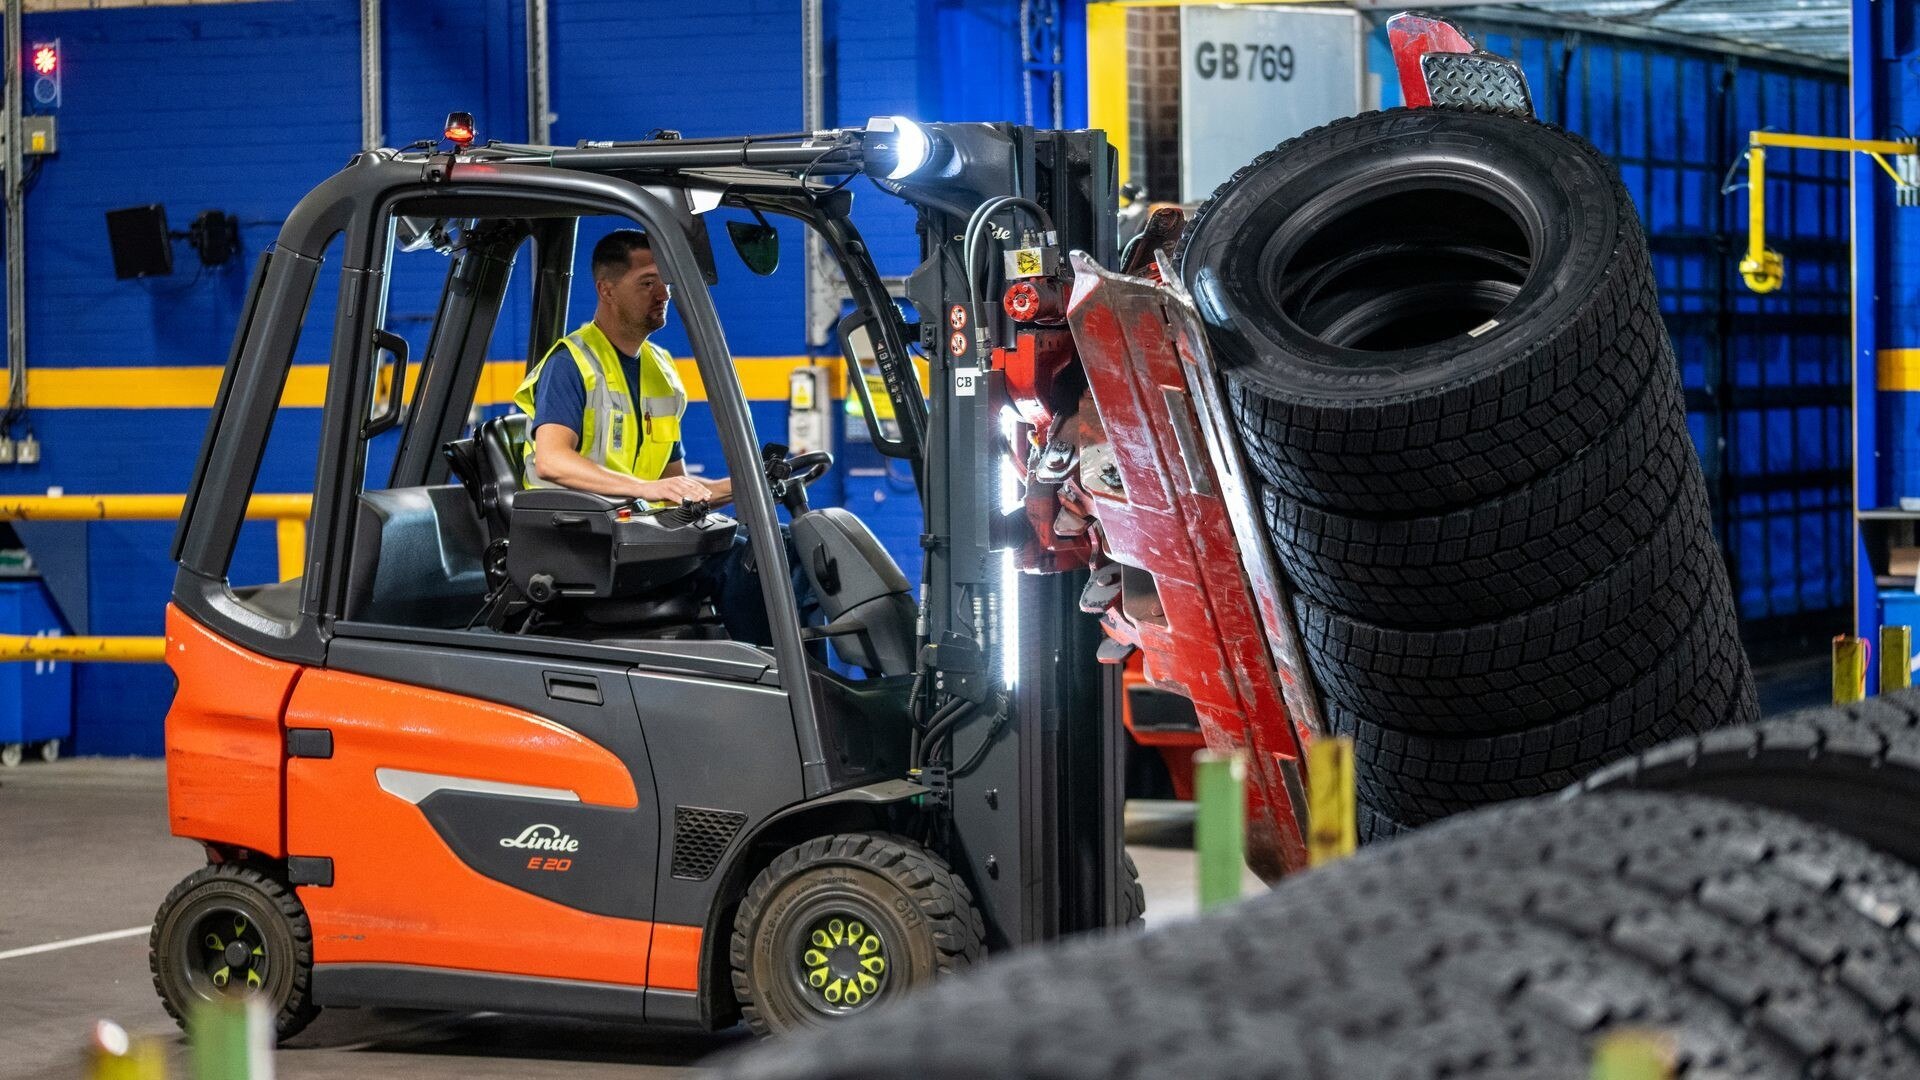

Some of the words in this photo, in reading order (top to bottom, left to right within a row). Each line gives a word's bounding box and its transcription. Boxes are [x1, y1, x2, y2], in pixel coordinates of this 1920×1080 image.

[956, 376, 972, 388] CB
[499, 823, 579, 852] Linde
[527, 857, 543, 869] E
[543, 858, 572, 871] 20
[895, 898, 922, 930] GRI
